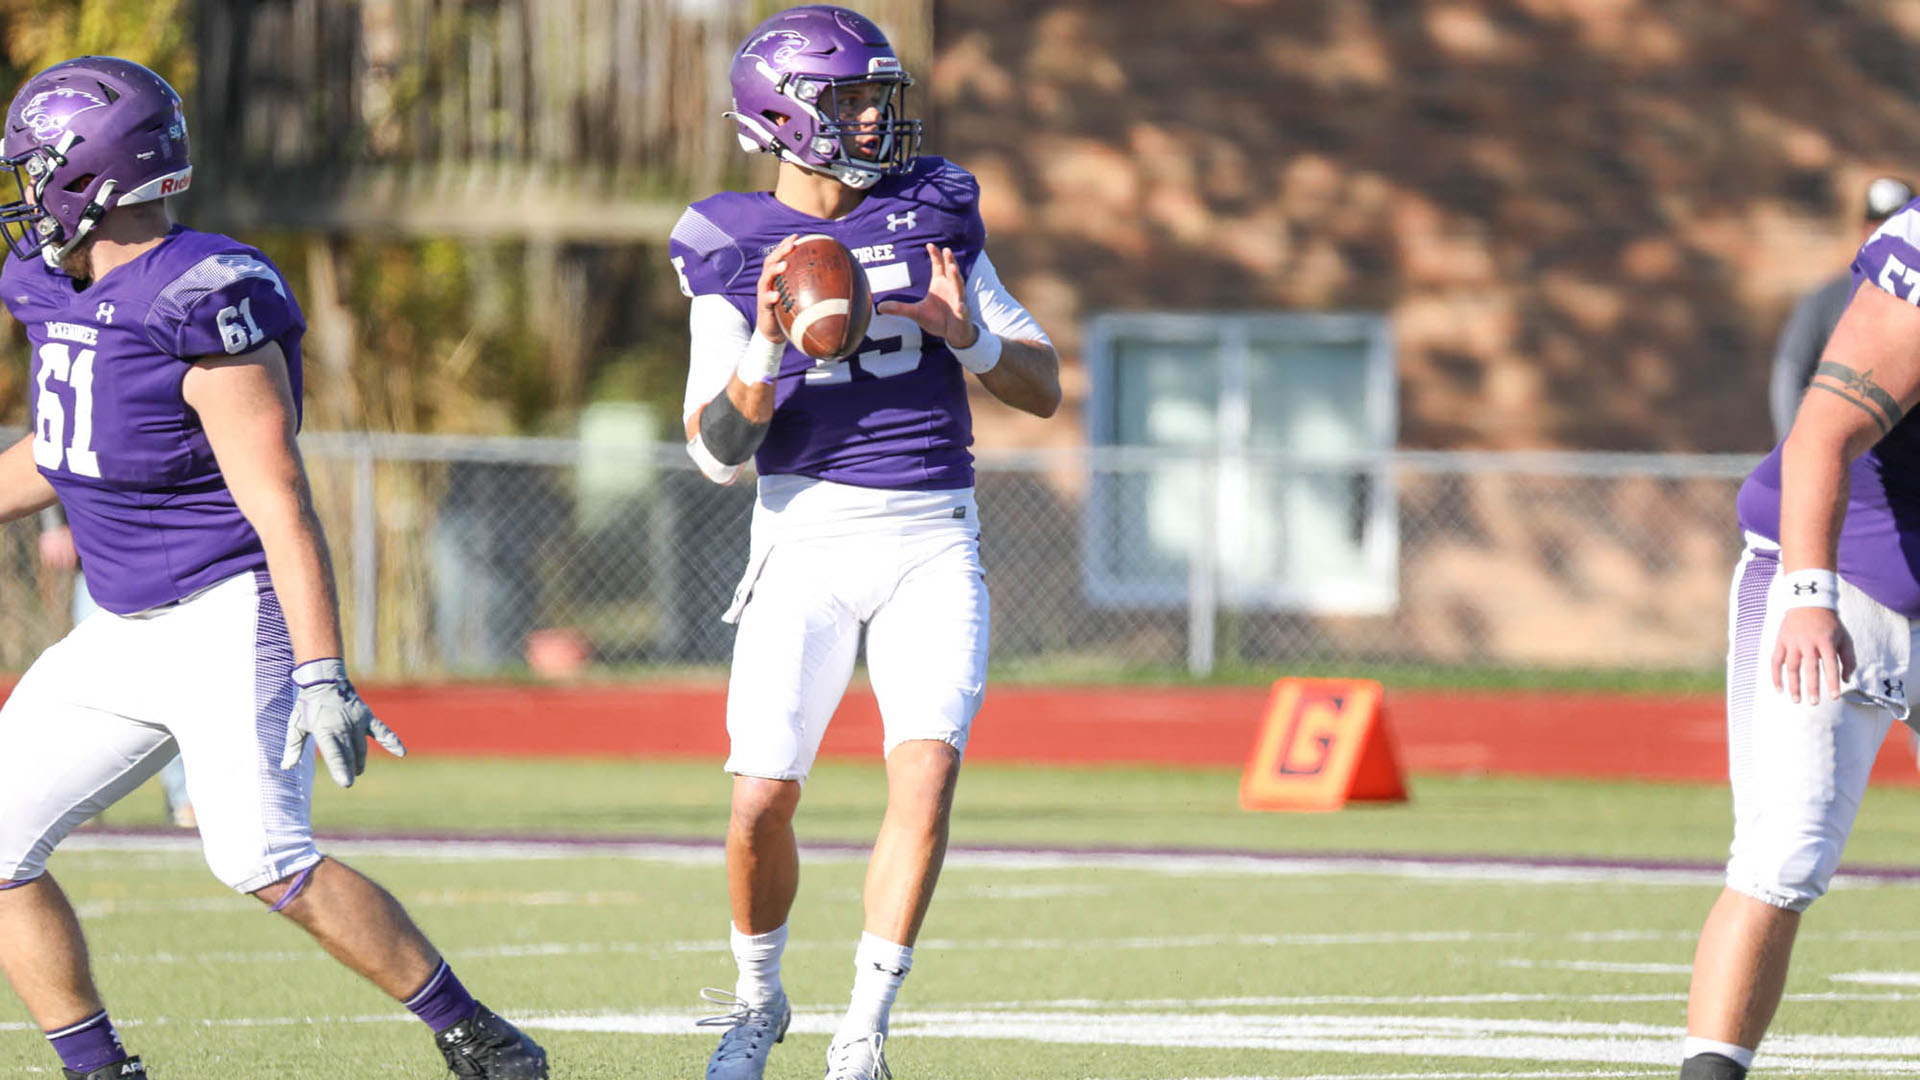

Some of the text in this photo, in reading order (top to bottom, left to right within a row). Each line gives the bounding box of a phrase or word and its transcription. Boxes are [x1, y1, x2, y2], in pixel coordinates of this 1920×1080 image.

[215, 296, 265, 355] 61
[32, 342, 102, 478] 61
[1277, 690, 1345, 778] G
